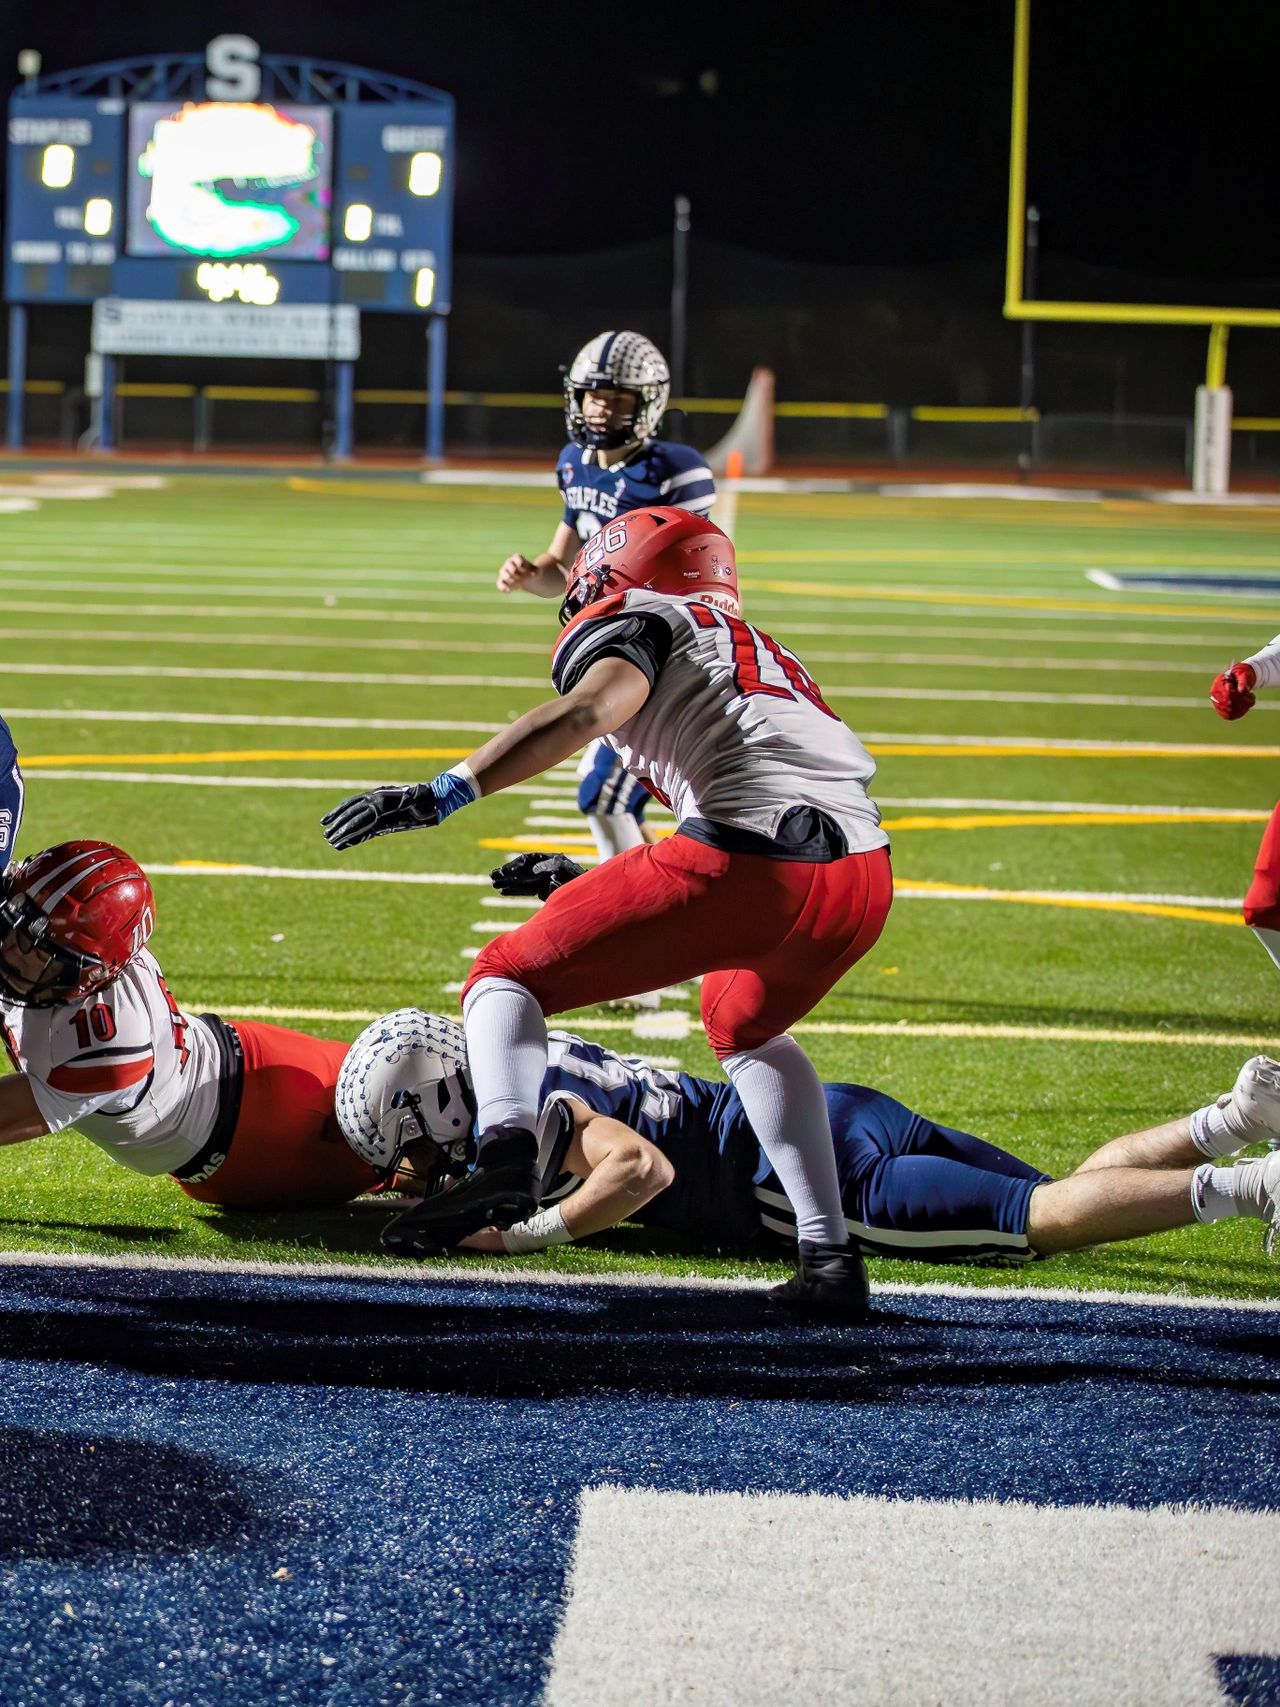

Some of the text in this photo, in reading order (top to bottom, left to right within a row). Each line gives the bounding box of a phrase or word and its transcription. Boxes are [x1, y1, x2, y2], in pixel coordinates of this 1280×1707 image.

[205, 33, 261, 102] S
[584, 520, 628, 570] 26
[69, 1003, 117, 1049] 10
